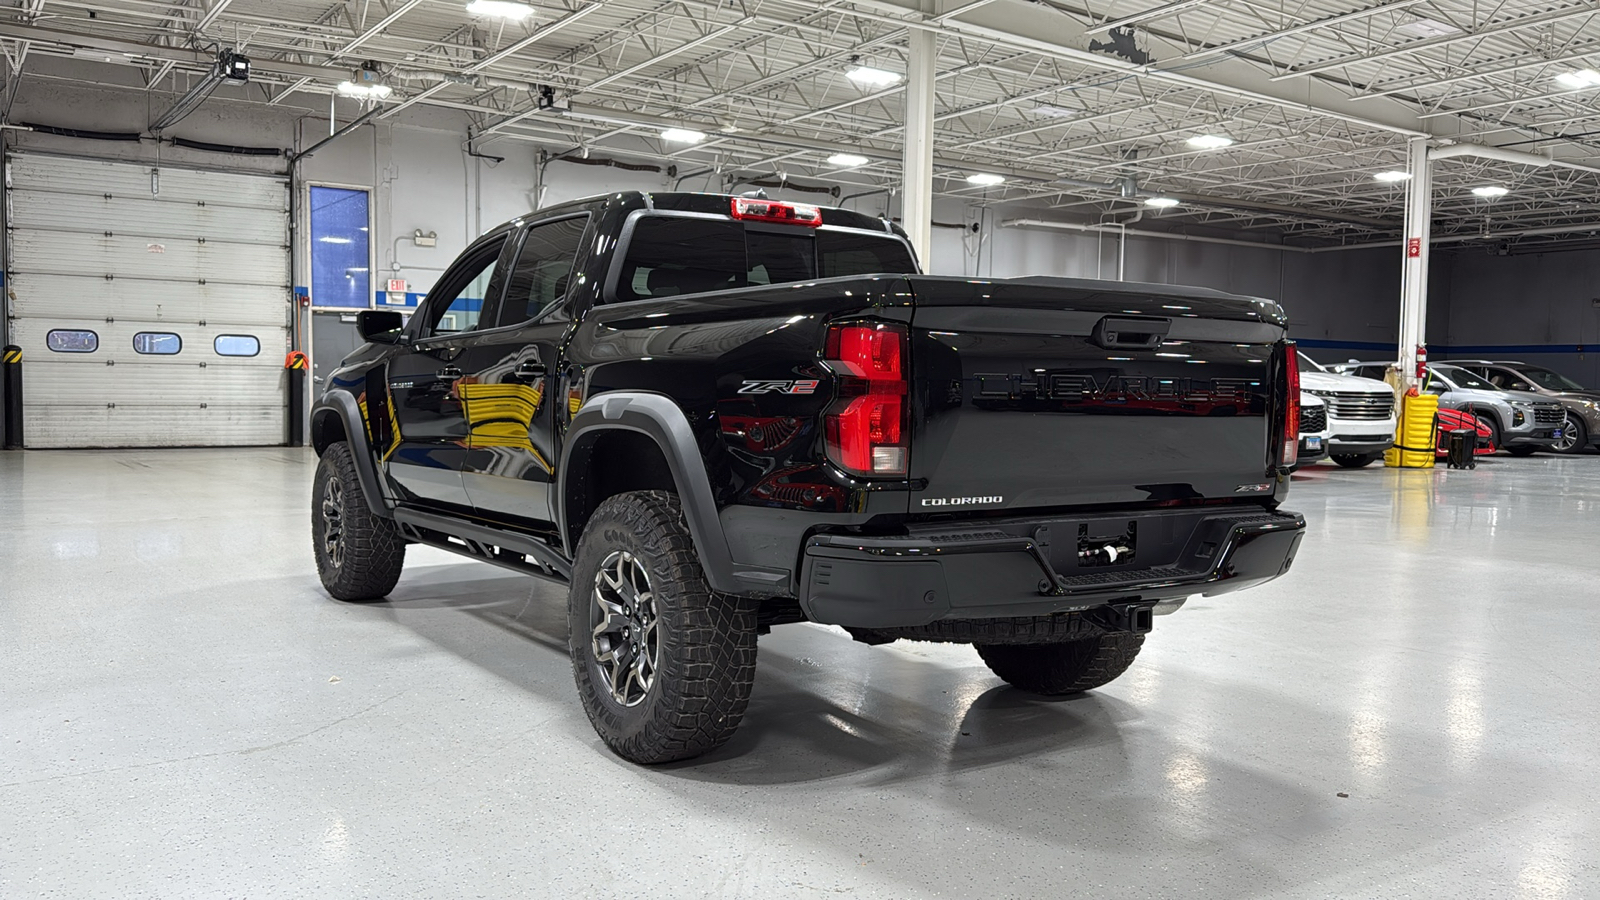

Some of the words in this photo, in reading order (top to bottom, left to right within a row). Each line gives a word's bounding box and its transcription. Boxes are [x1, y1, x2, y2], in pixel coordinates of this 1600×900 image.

[390, 279, 405, 291] EXIT
[737, 379, 820, 394] ZR2
[971, 373, 1261, 403] CHEVROLET
[921, 495, 1003, 506] COLORADO
